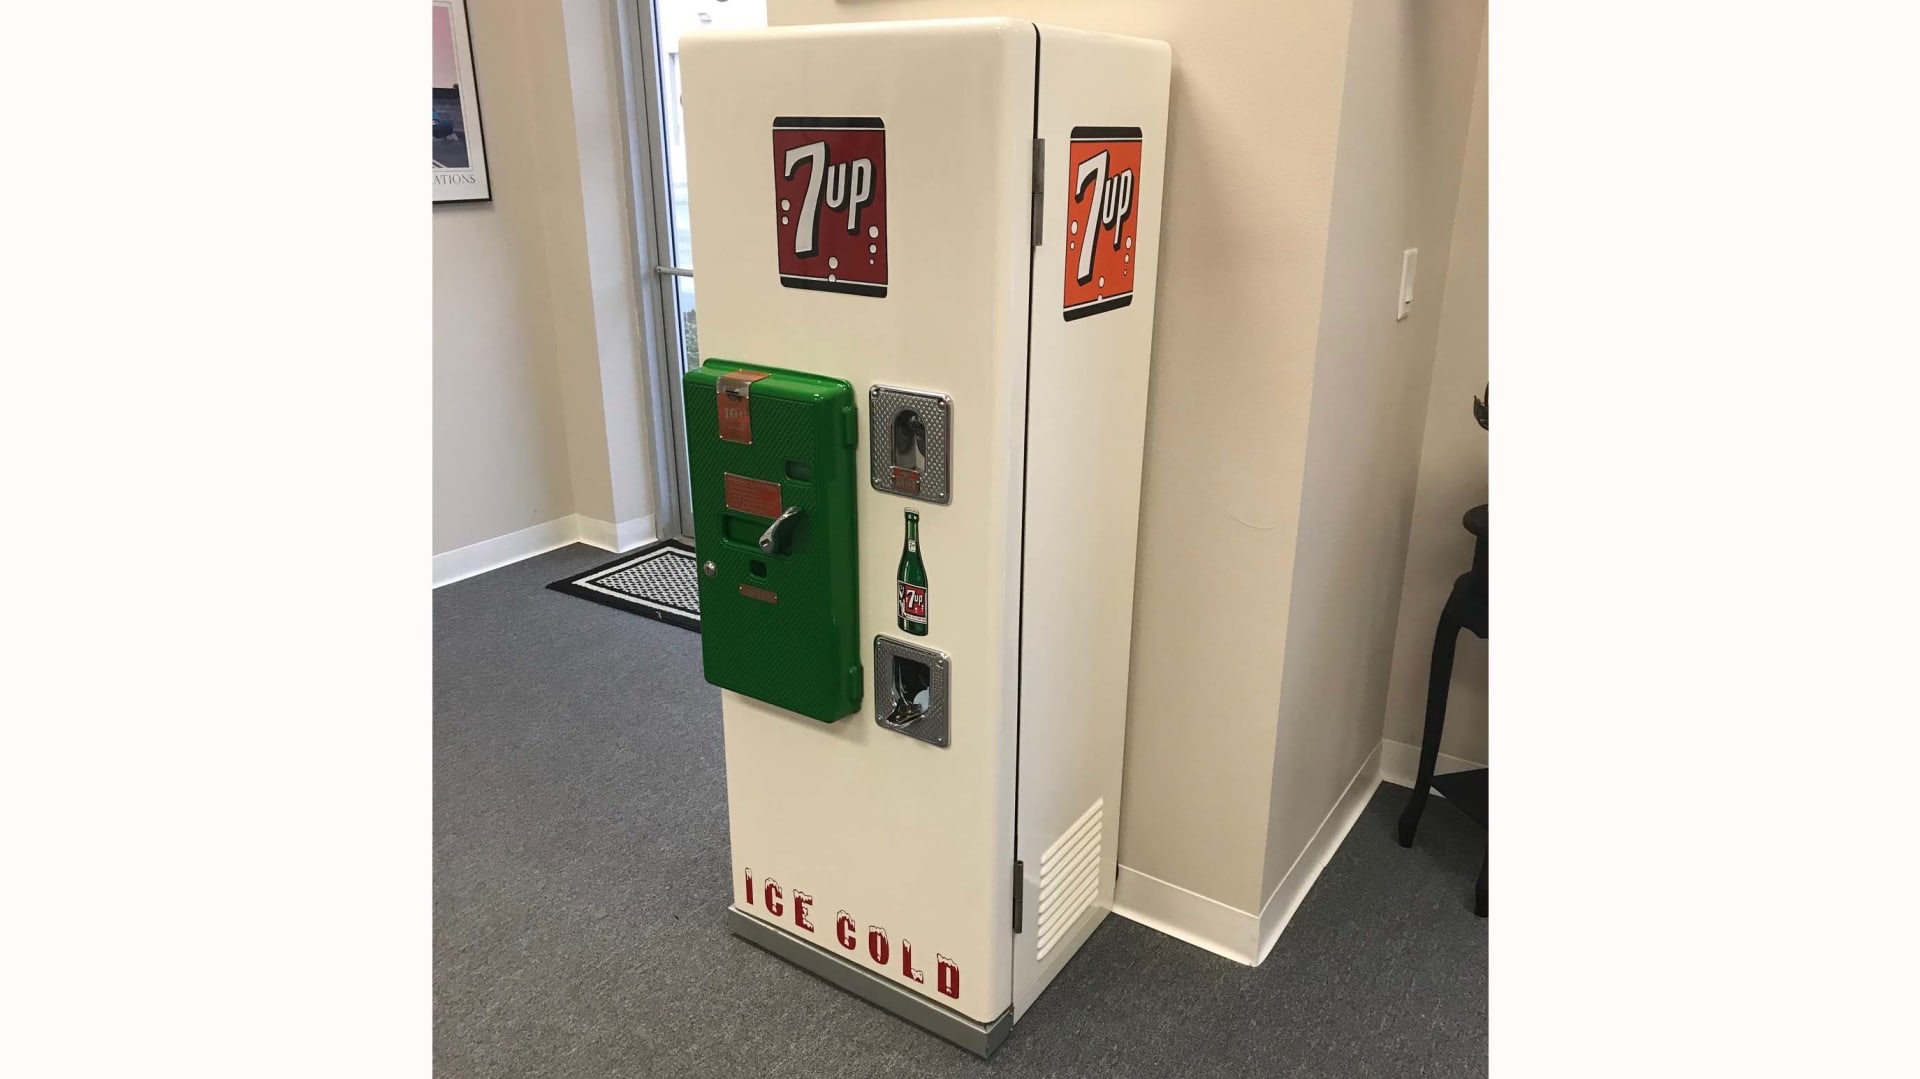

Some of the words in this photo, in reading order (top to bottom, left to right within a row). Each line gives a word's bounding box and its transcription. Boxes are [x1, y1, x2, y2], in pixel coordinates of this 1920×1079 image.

[432, 174, 477, 185] ATIONS
[745, 867, 815, 933] ICE
[836, 909, 960, 1000] COLD
